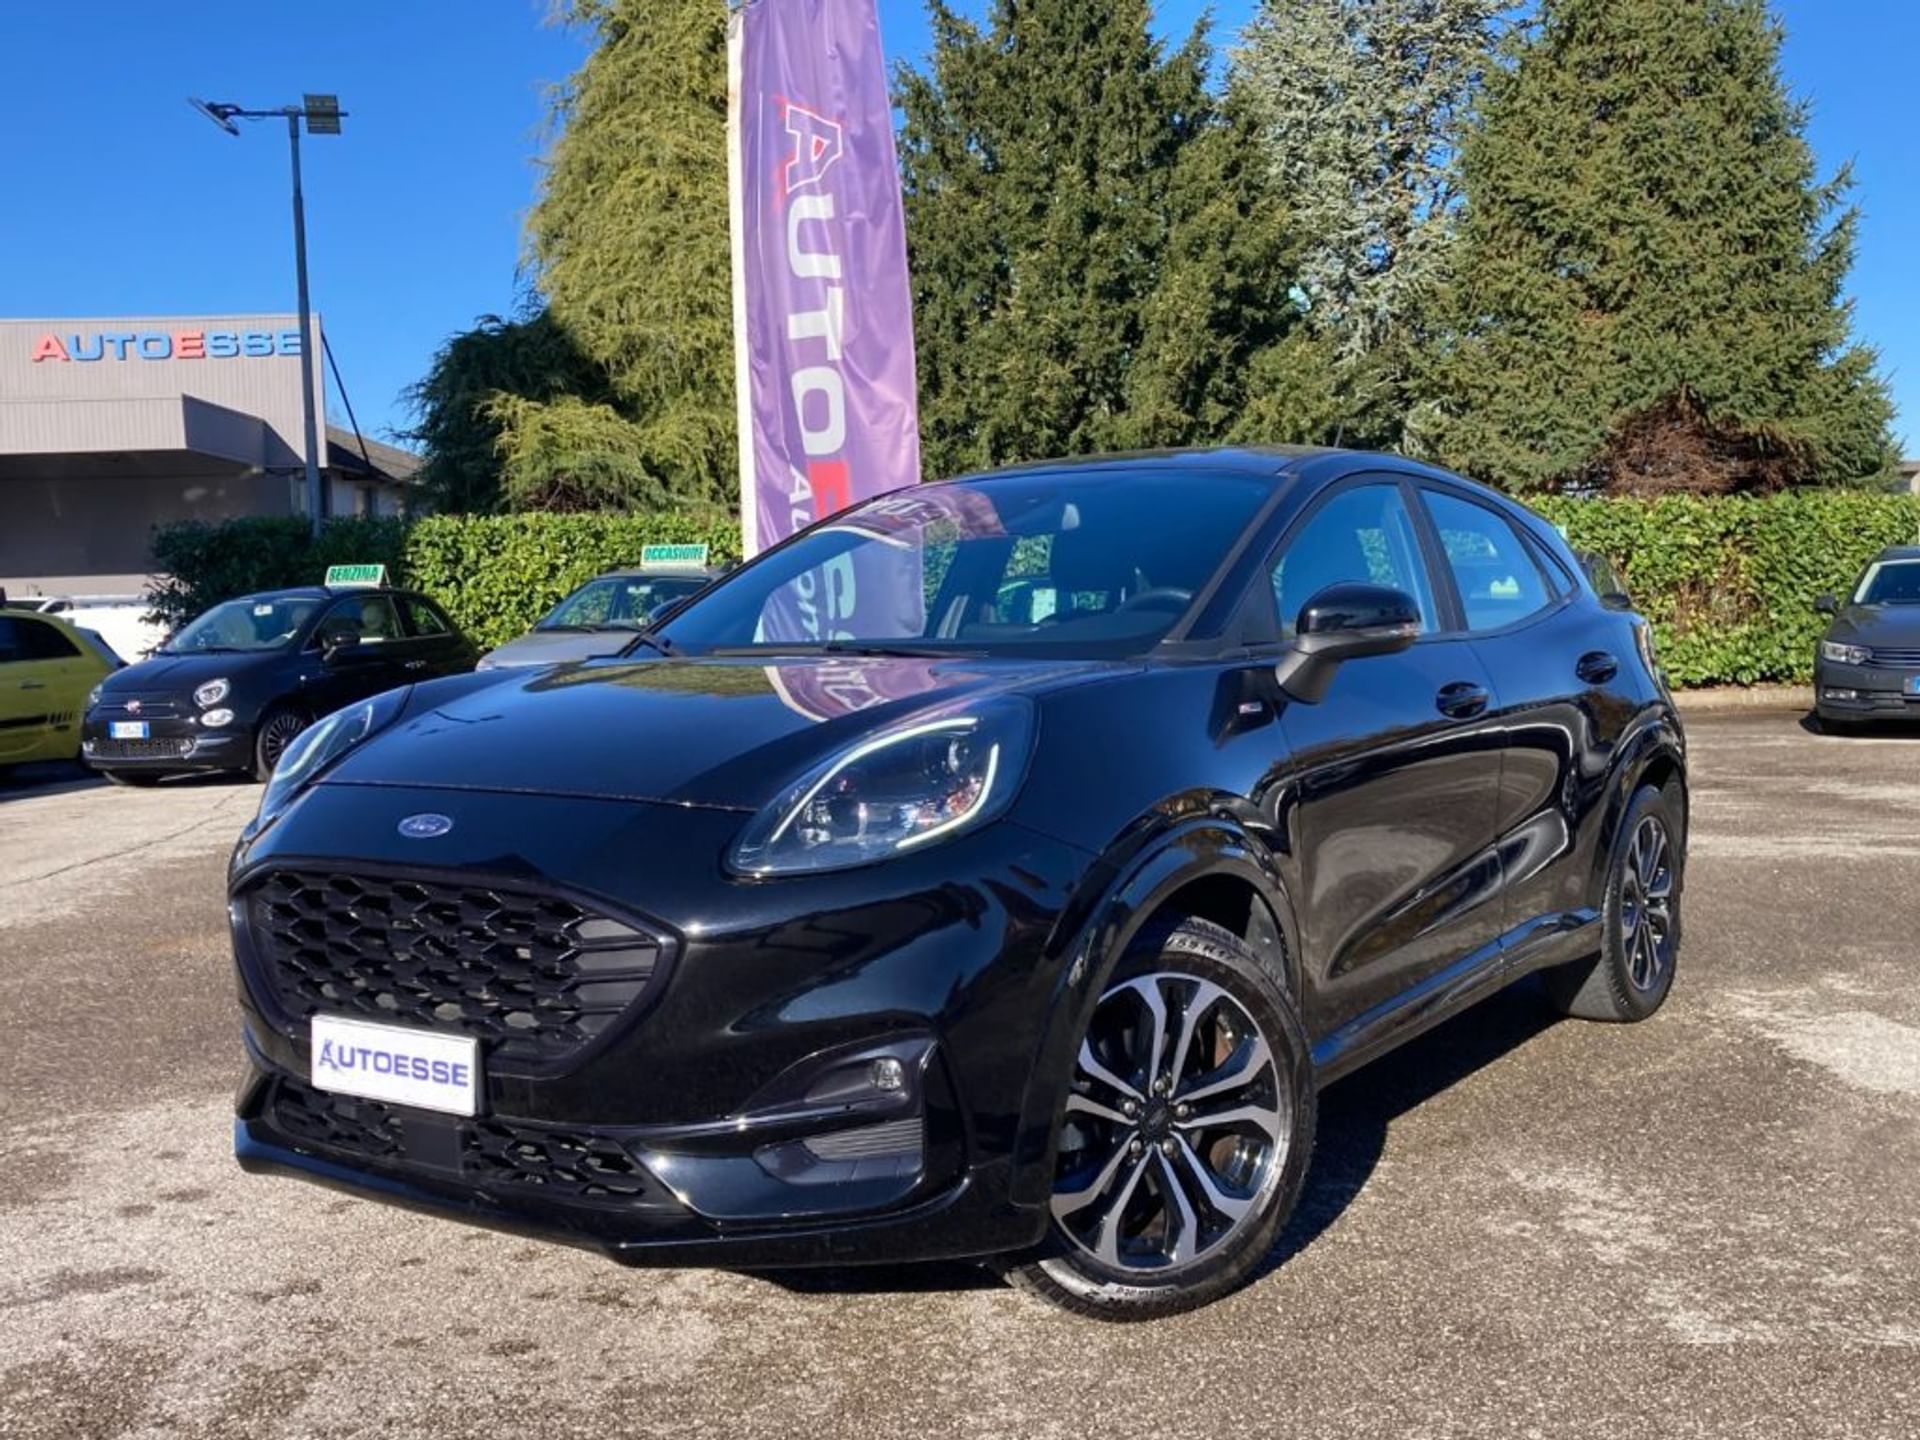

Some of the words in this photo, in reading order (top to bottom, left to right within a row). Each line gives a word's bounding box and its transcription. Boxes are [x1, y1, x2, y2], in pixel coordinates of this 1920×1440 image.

[32, 330, 300, 362] AUTOESSE
[644, 546, 704, 560] OCCASIONE
[329, 566, 379, 582] BENZINA
[319, 1038, 469, 1087] AUTOESSE
